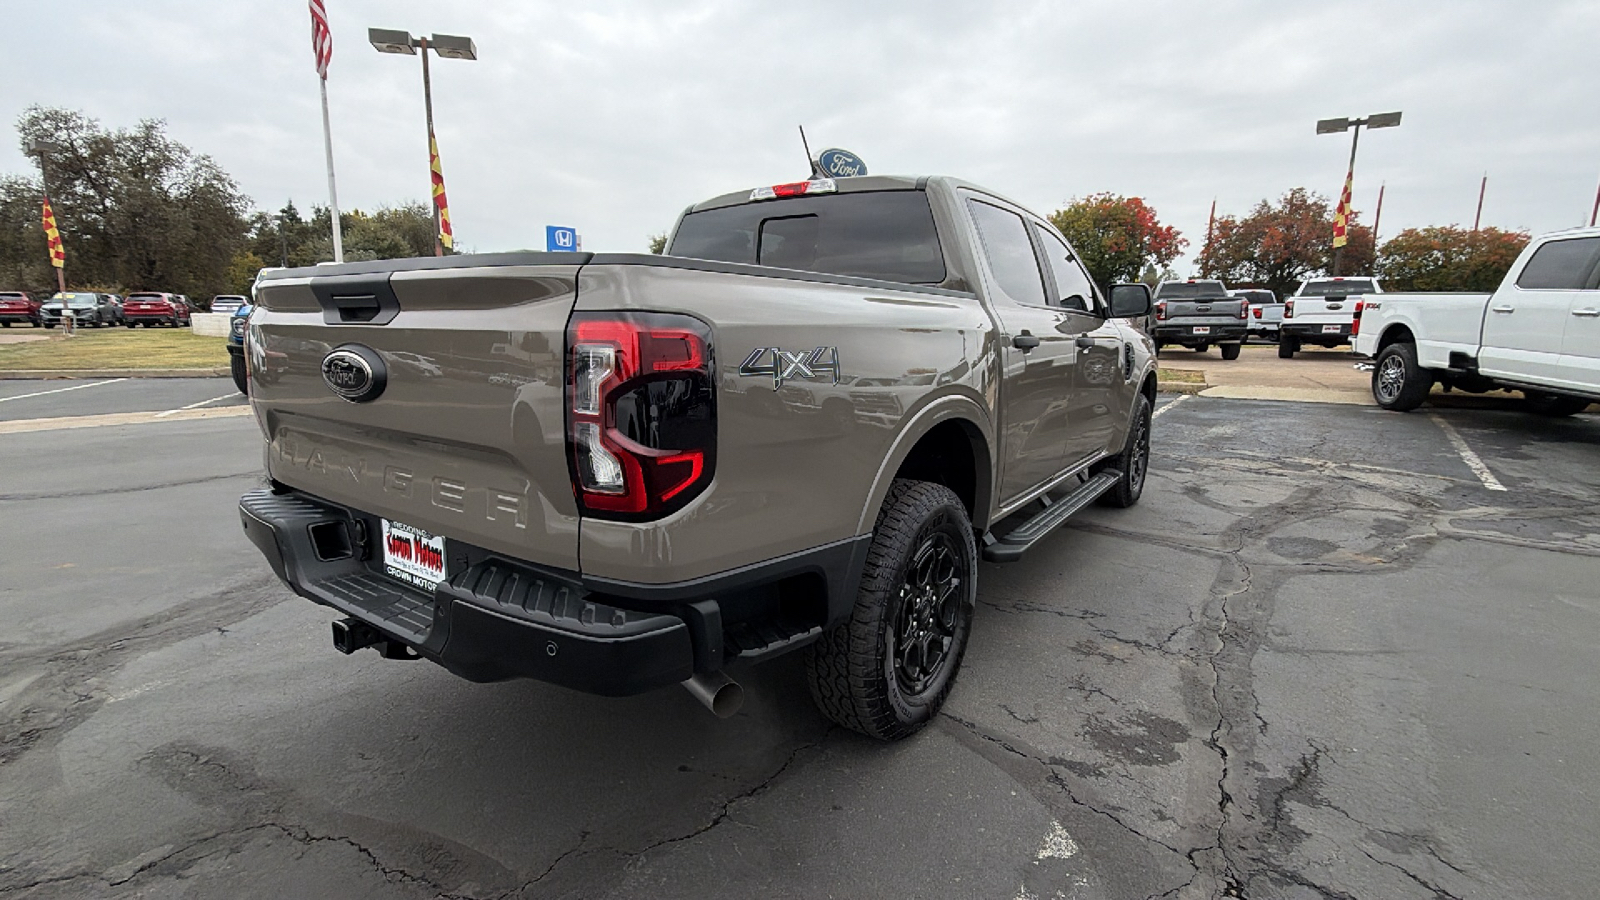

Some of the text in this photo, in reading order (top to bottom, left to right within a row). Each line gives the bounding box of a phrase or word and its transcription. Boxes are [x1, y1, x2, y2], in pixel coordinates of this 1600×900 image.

[830, 154, 861, 177] Ford
[329, 360, 357, 386] Ford
[279, 432, 529, 529] RANGER
[392, 521, 429, 538] REDDING
[386, 532, 412, 562] Crown
[413, 534, 443, 573] Motors
[386, 566, 412, 582] CROWN
[412, 576, 438, 592] MOTOR
